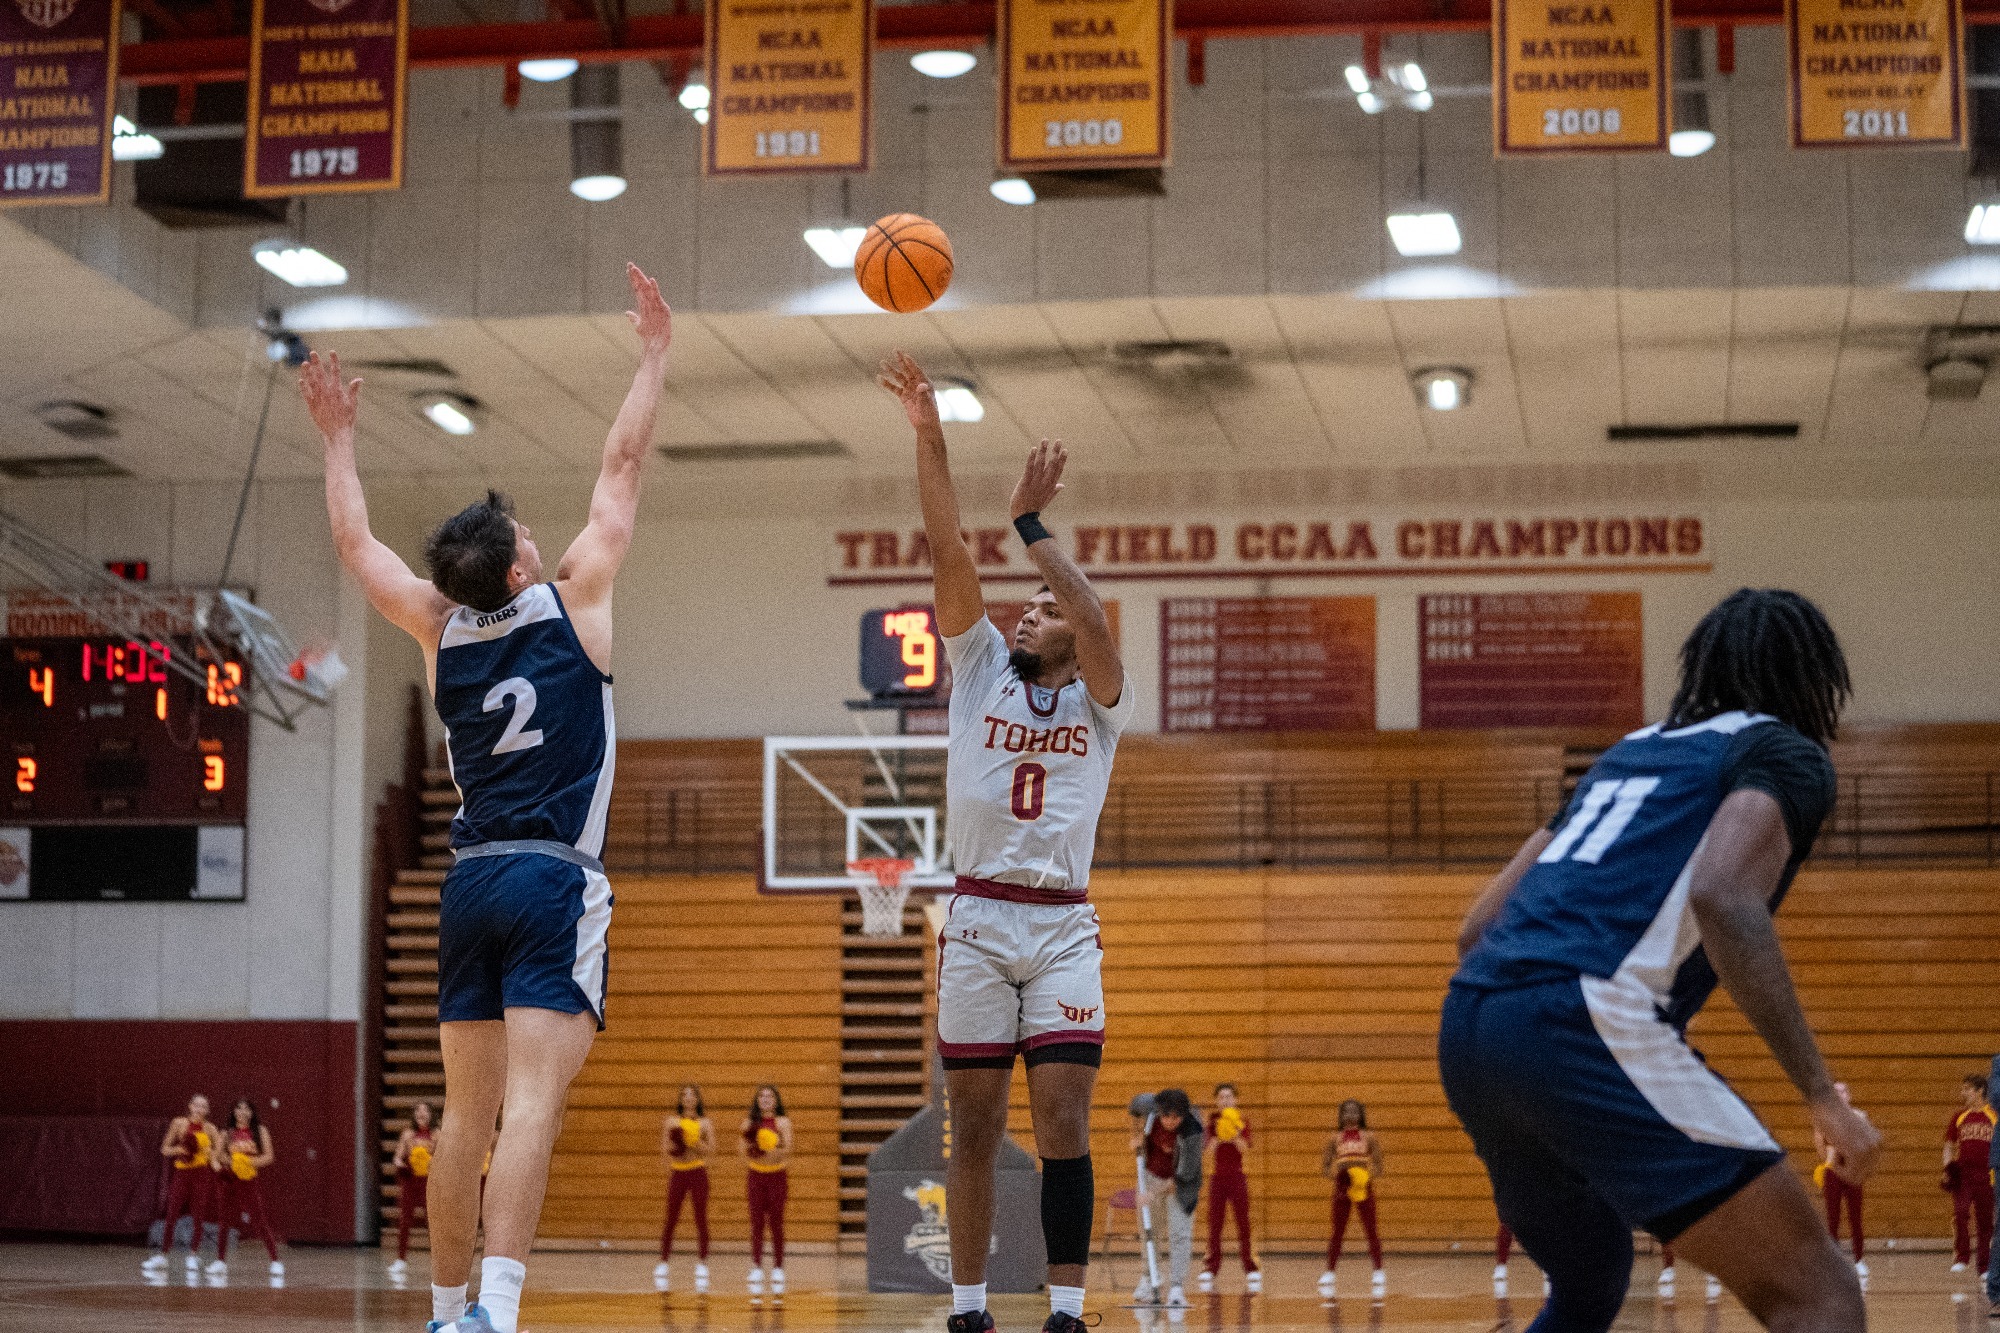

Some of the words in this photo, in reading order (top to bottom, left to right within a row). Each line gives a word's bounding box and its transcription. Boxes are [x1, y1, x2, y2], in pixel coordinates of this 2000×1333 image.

[1052, 18, 1116, 38] NCAA
[1548, 5, 1613, 27] NCAA
[758, 30, 822, 50] NCAA
[1813, 20, 1934, 43] NATIONAL
[299, 48, 358, 73] NAIA
[1025, 49, 1143, 72] NATIONAL
[1522, 37, 1640, 60] NATIONAL
[15, 64, 70, 89] NAIA
[731, 59, 848, 83] NATIONAL
[1806, 54, 1942, 76] CHAMPIONS
[270, 79, 384, 106] NATIONAL
[1016, 82, 1151, 105] CHAMPIONS
[1513, 69, 1649, 93] CHAMPIONS
[0, 95, 93, 120] ATIONAL
[723, 92, 854, 116] CHAMPIONS
[262, 109, 390, 137] CHAMPIONS
[1045, 119, 1122, 147] 2000
[1844, 109, 1909, 137] 2011
[754, 131, 820, 157] 1991
[290, 148, 359, 178] 1975
[4, 162, 69, 190] 1975
[836, 529, 1009, 569] TRAK
[1075, 524, 1217, 565] FIELD
[1236, 521, 1378, 561] CCAA
[1396, 517, 1704, 558] CHAMPIONS
[476, 605, 519, 629] OTTERS
[903, 632, 936, 688] 9
[29, 666, 55, 708] 4
[156, 688, 167, 720] 1
[482, 676, 544, 756] 2
[16, 756, 37, 792] 2
[204, 755, 225, 791] 3
[1010, 762, 1047, 822] 0
[1537, 776, 1662, 865] 11
[1058, 1000, 1098, 1025] DH
